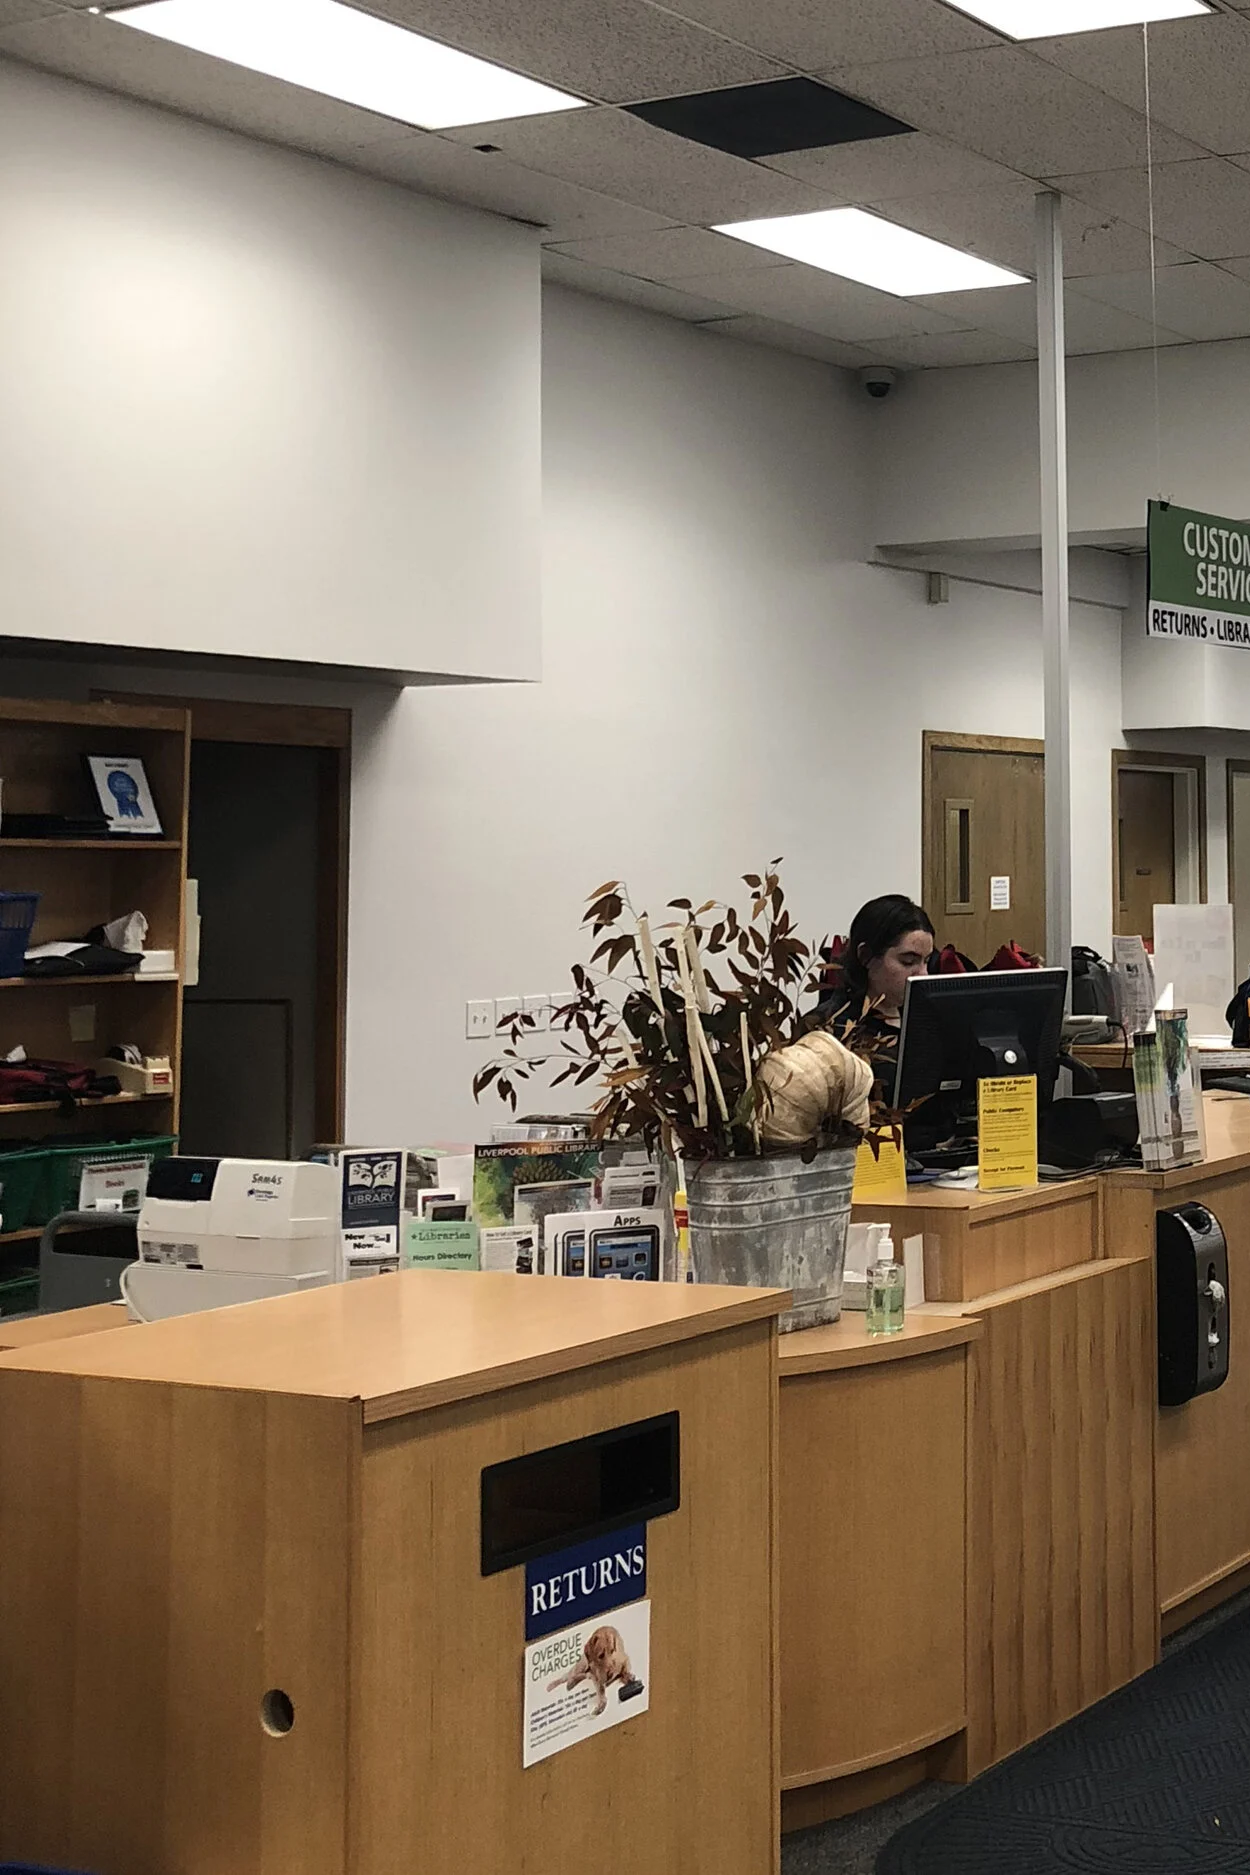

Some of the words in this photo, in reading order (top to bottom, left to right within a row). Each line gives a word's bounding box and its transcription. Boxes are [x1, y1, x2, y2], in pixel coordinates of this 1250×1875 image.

[1152, 608, 1208, 639] RETURNS
[477, 1146, 529, 1157] LIVERPOOL
[530, 1144, 563, 1155] PUBLIC
[347, 1191, 396, 1205] LIBRARY
[437, 1251, 472, 1261] Directory
[531, 1544, 645, 1616] RETURNS
[531, 1632, 582, 1667] OVERDUE
[531, 1648, 582, 1682] CHARGES
